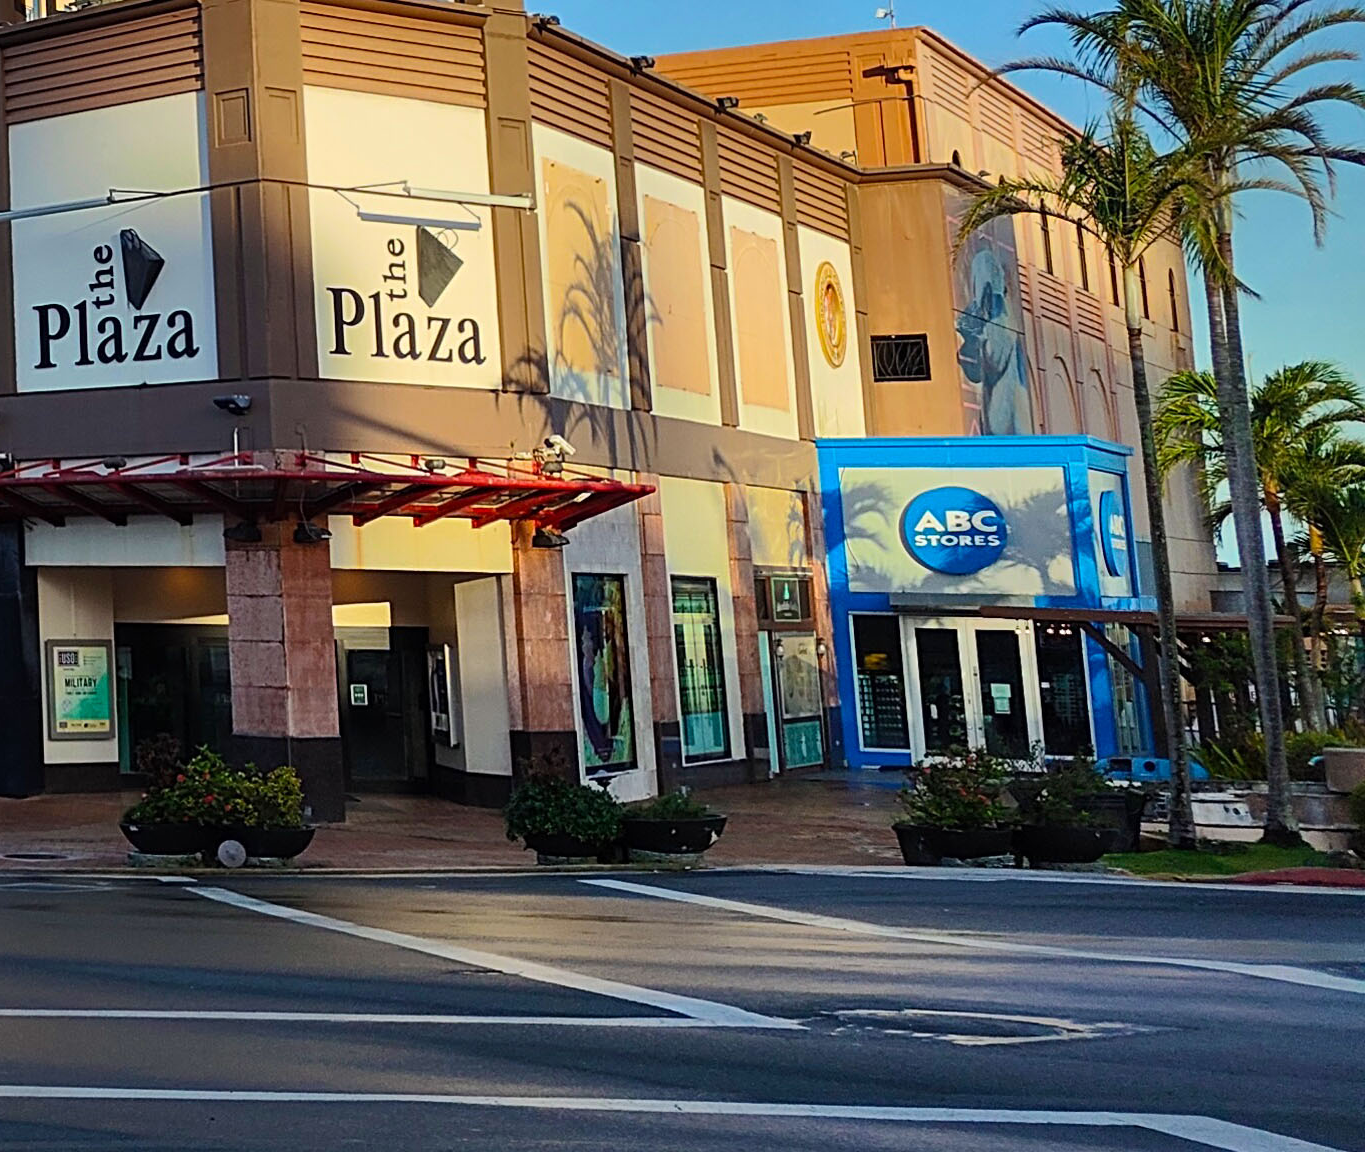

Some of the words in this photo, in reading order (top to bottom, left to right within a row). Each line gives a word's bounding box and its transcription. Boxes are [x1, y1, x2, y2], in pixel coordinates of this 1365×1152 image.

[88, 244, 115, 310] the
[382, 238, 408, 302] the
[32, 299, 200, 369] Plaza
[325, 287, 487, 366] Plaza
[914, 510, 998, 533] ABC
[914, 534, 1001, 547] STORES
[61, 652, 75, 664] USO
[64, 678, 97, 688] MILITARY
